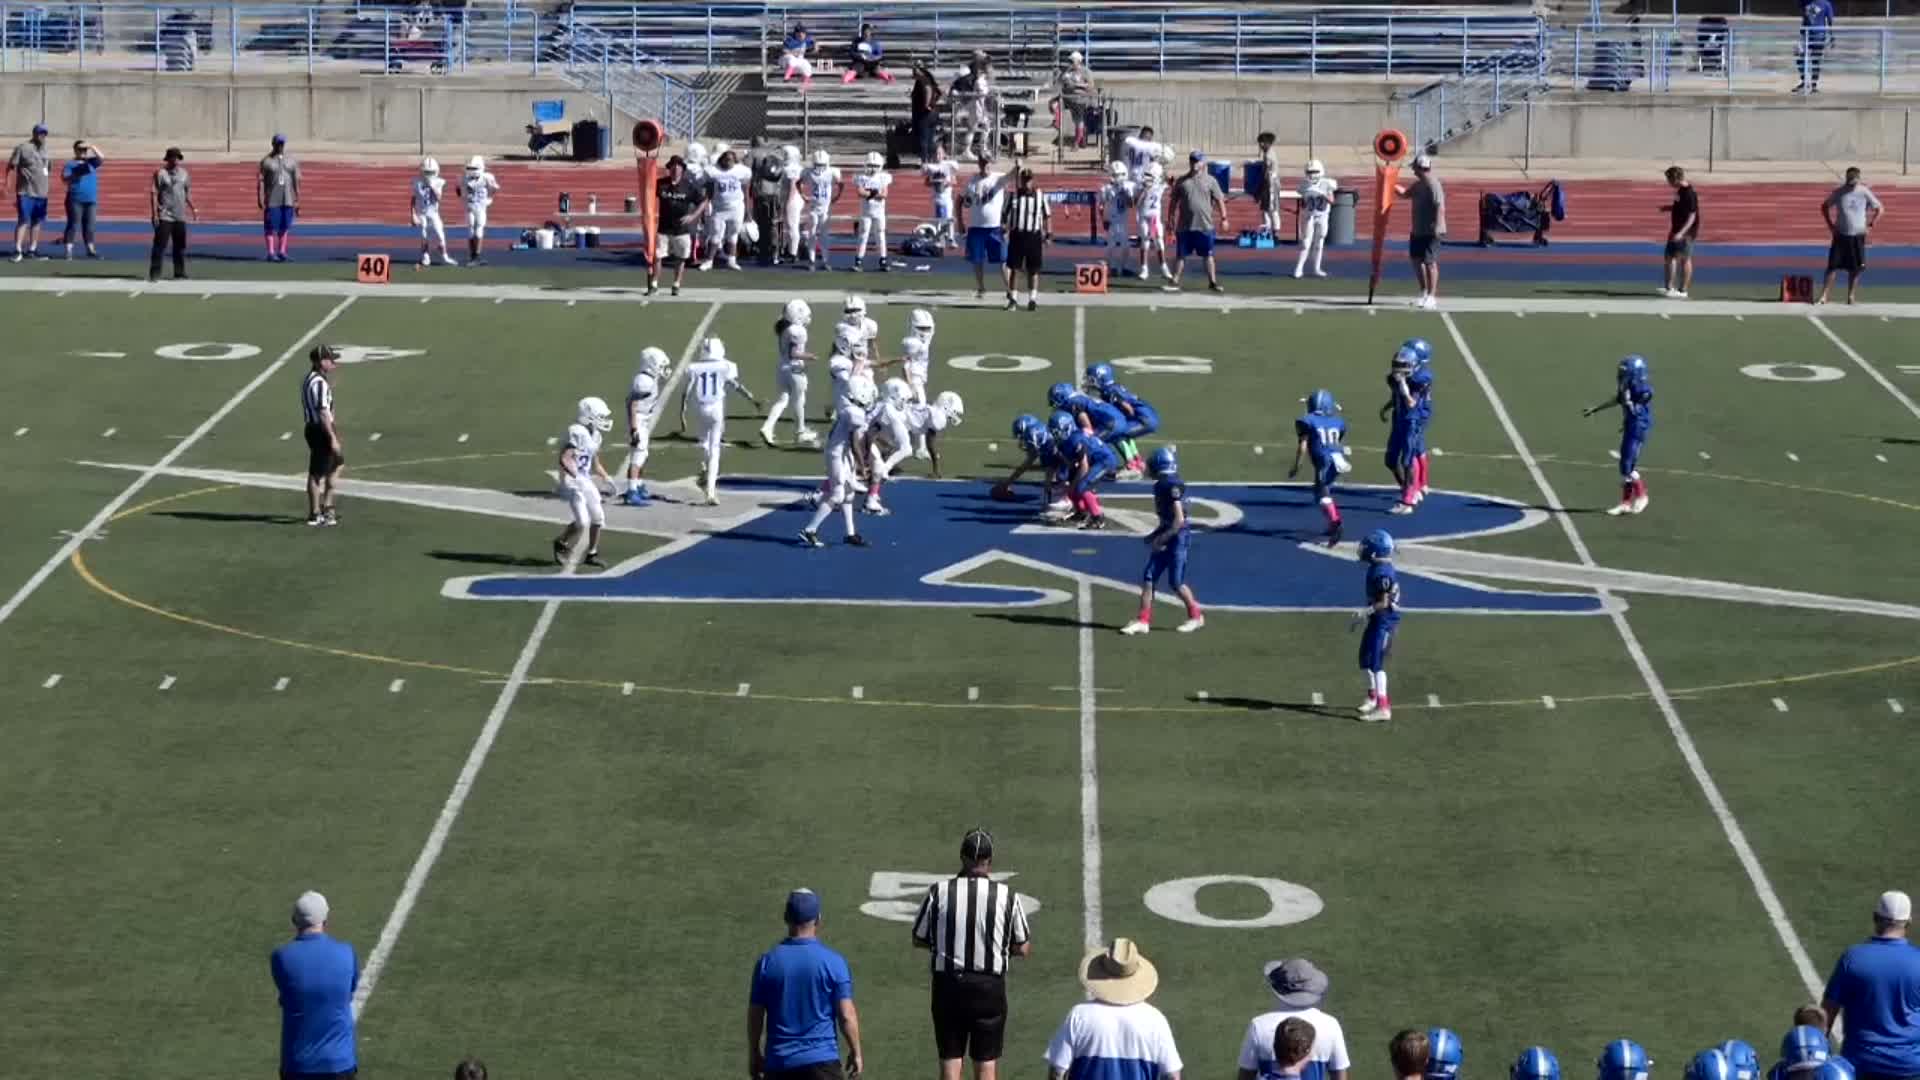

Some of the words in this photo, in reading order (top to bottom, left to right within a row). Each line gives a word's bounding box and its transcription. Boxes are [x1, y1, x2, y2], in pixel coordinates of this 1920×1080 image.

[360, 257, 385, 276] 40
[1078, 267, 1103, 286] 50
[699, 371, 718, 396] 11
[1316, 427, 1340, 449] 10
